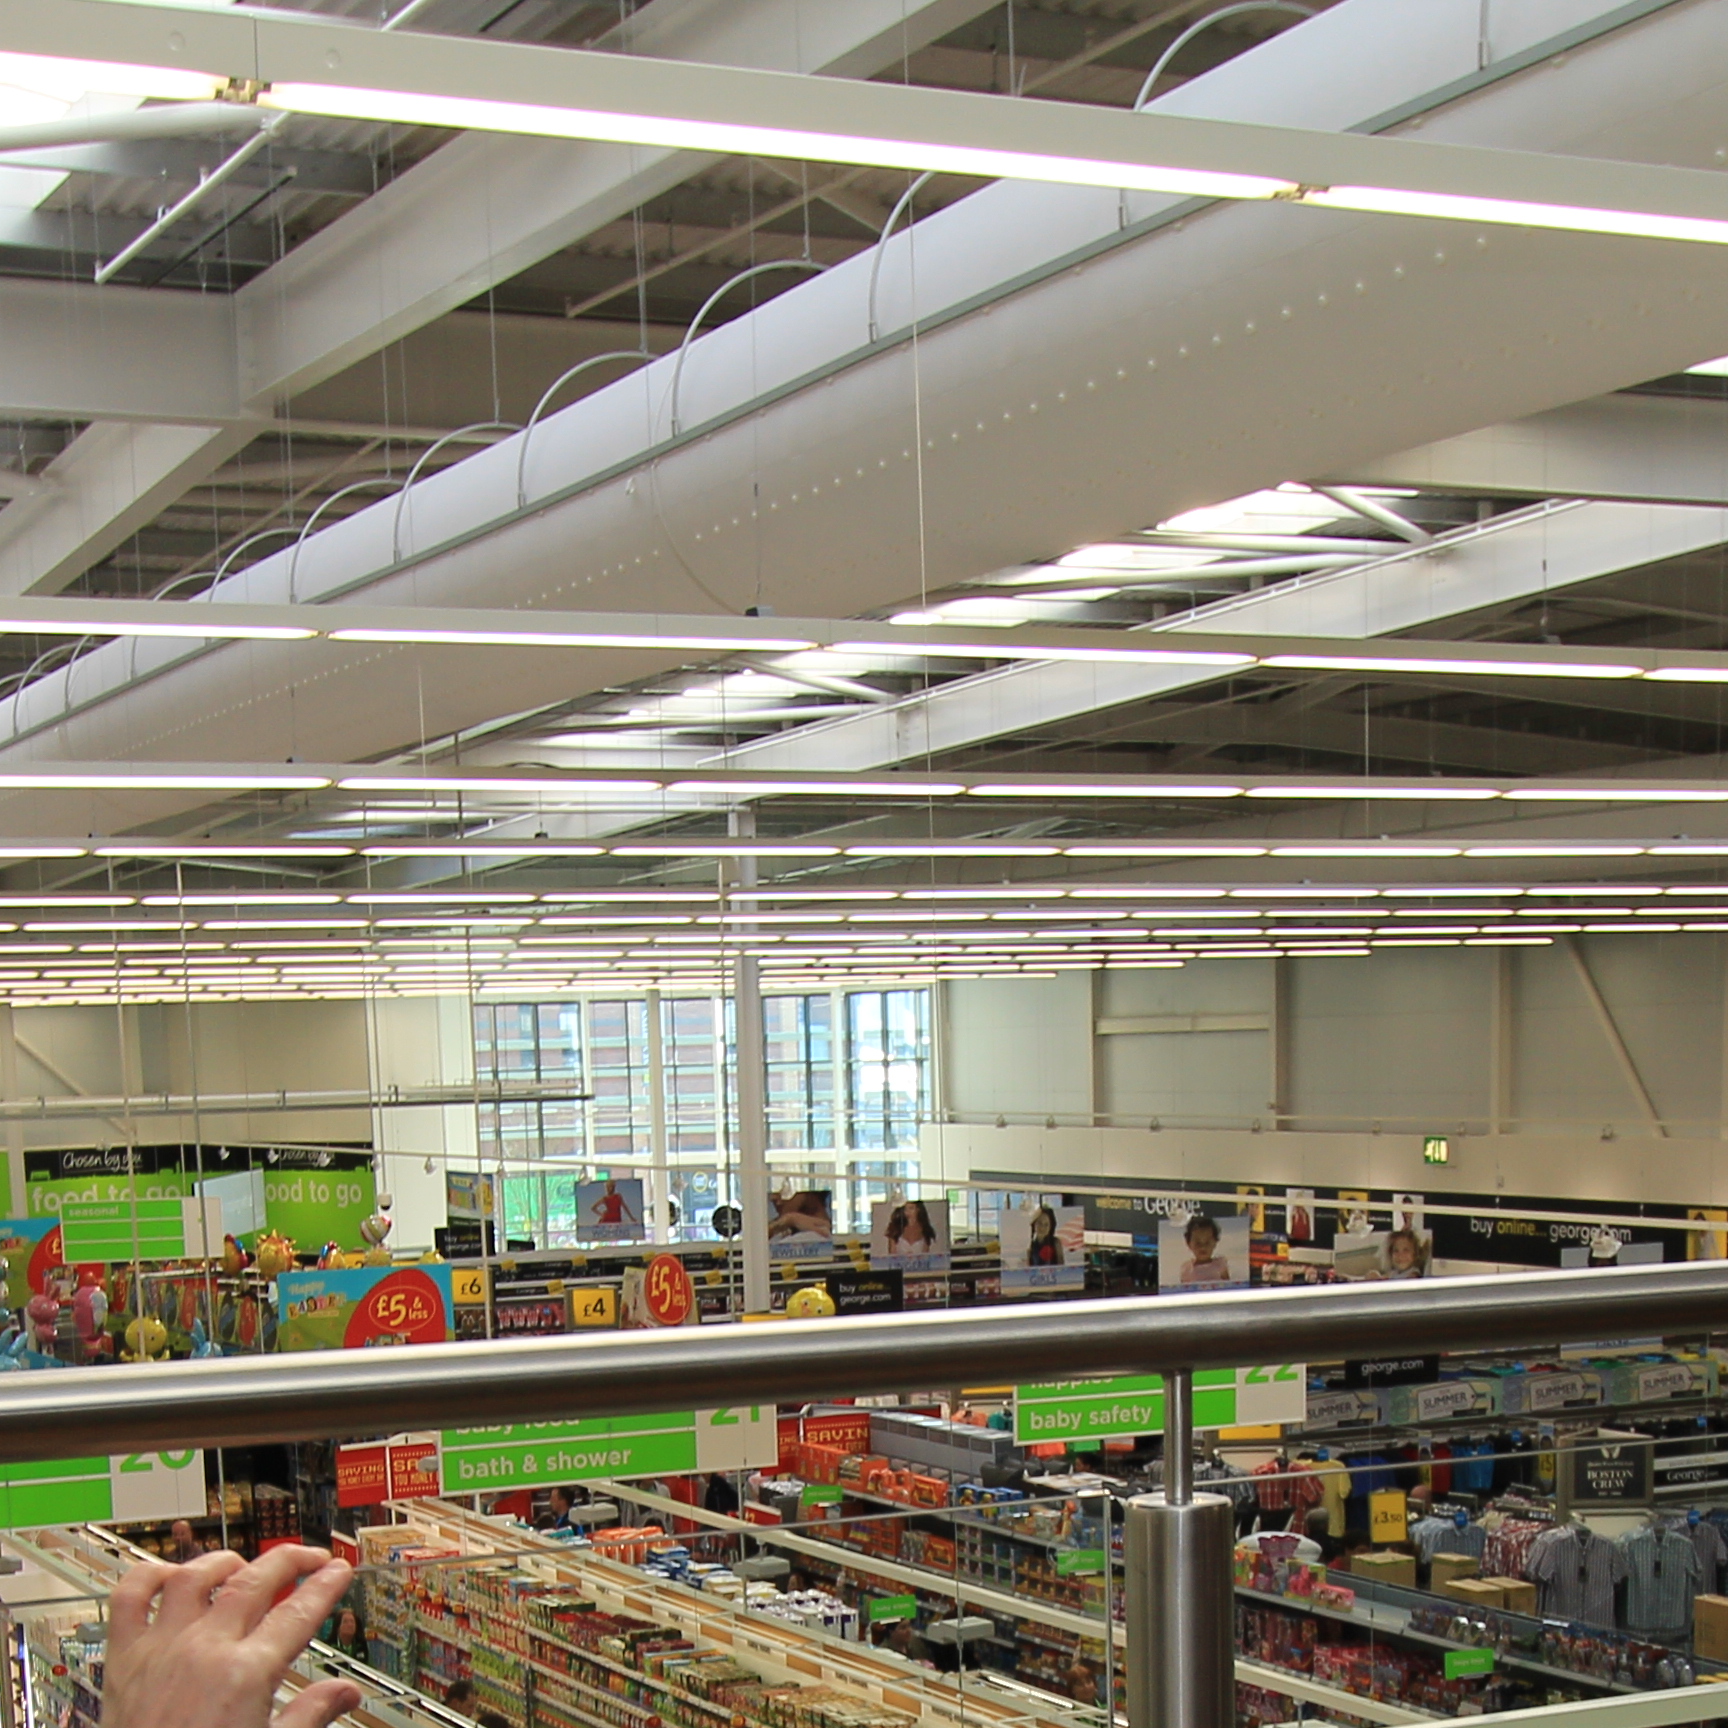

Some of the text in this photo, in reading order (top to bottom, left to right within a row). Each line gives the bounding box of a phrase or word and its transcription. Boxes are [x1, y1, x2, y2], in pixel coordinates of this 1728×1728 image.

[266, 1178, 362, 1208] ood to go
[68, 1206, 119, 1217] seasonal
[1471, 1217, 1493, 1239] buy
[460, 1277, 482, 1296] £6
[839, 1283, 857, 1294] buy
[376, 1293, 408, 1327] £5
[583, 1296, 607, 1318] £4
[1030, 1403, 1153, 1431] baby safety
[807, 1427, 869, 1443] SAVIN
[459, 1447, 632, 1480] bath & shower
